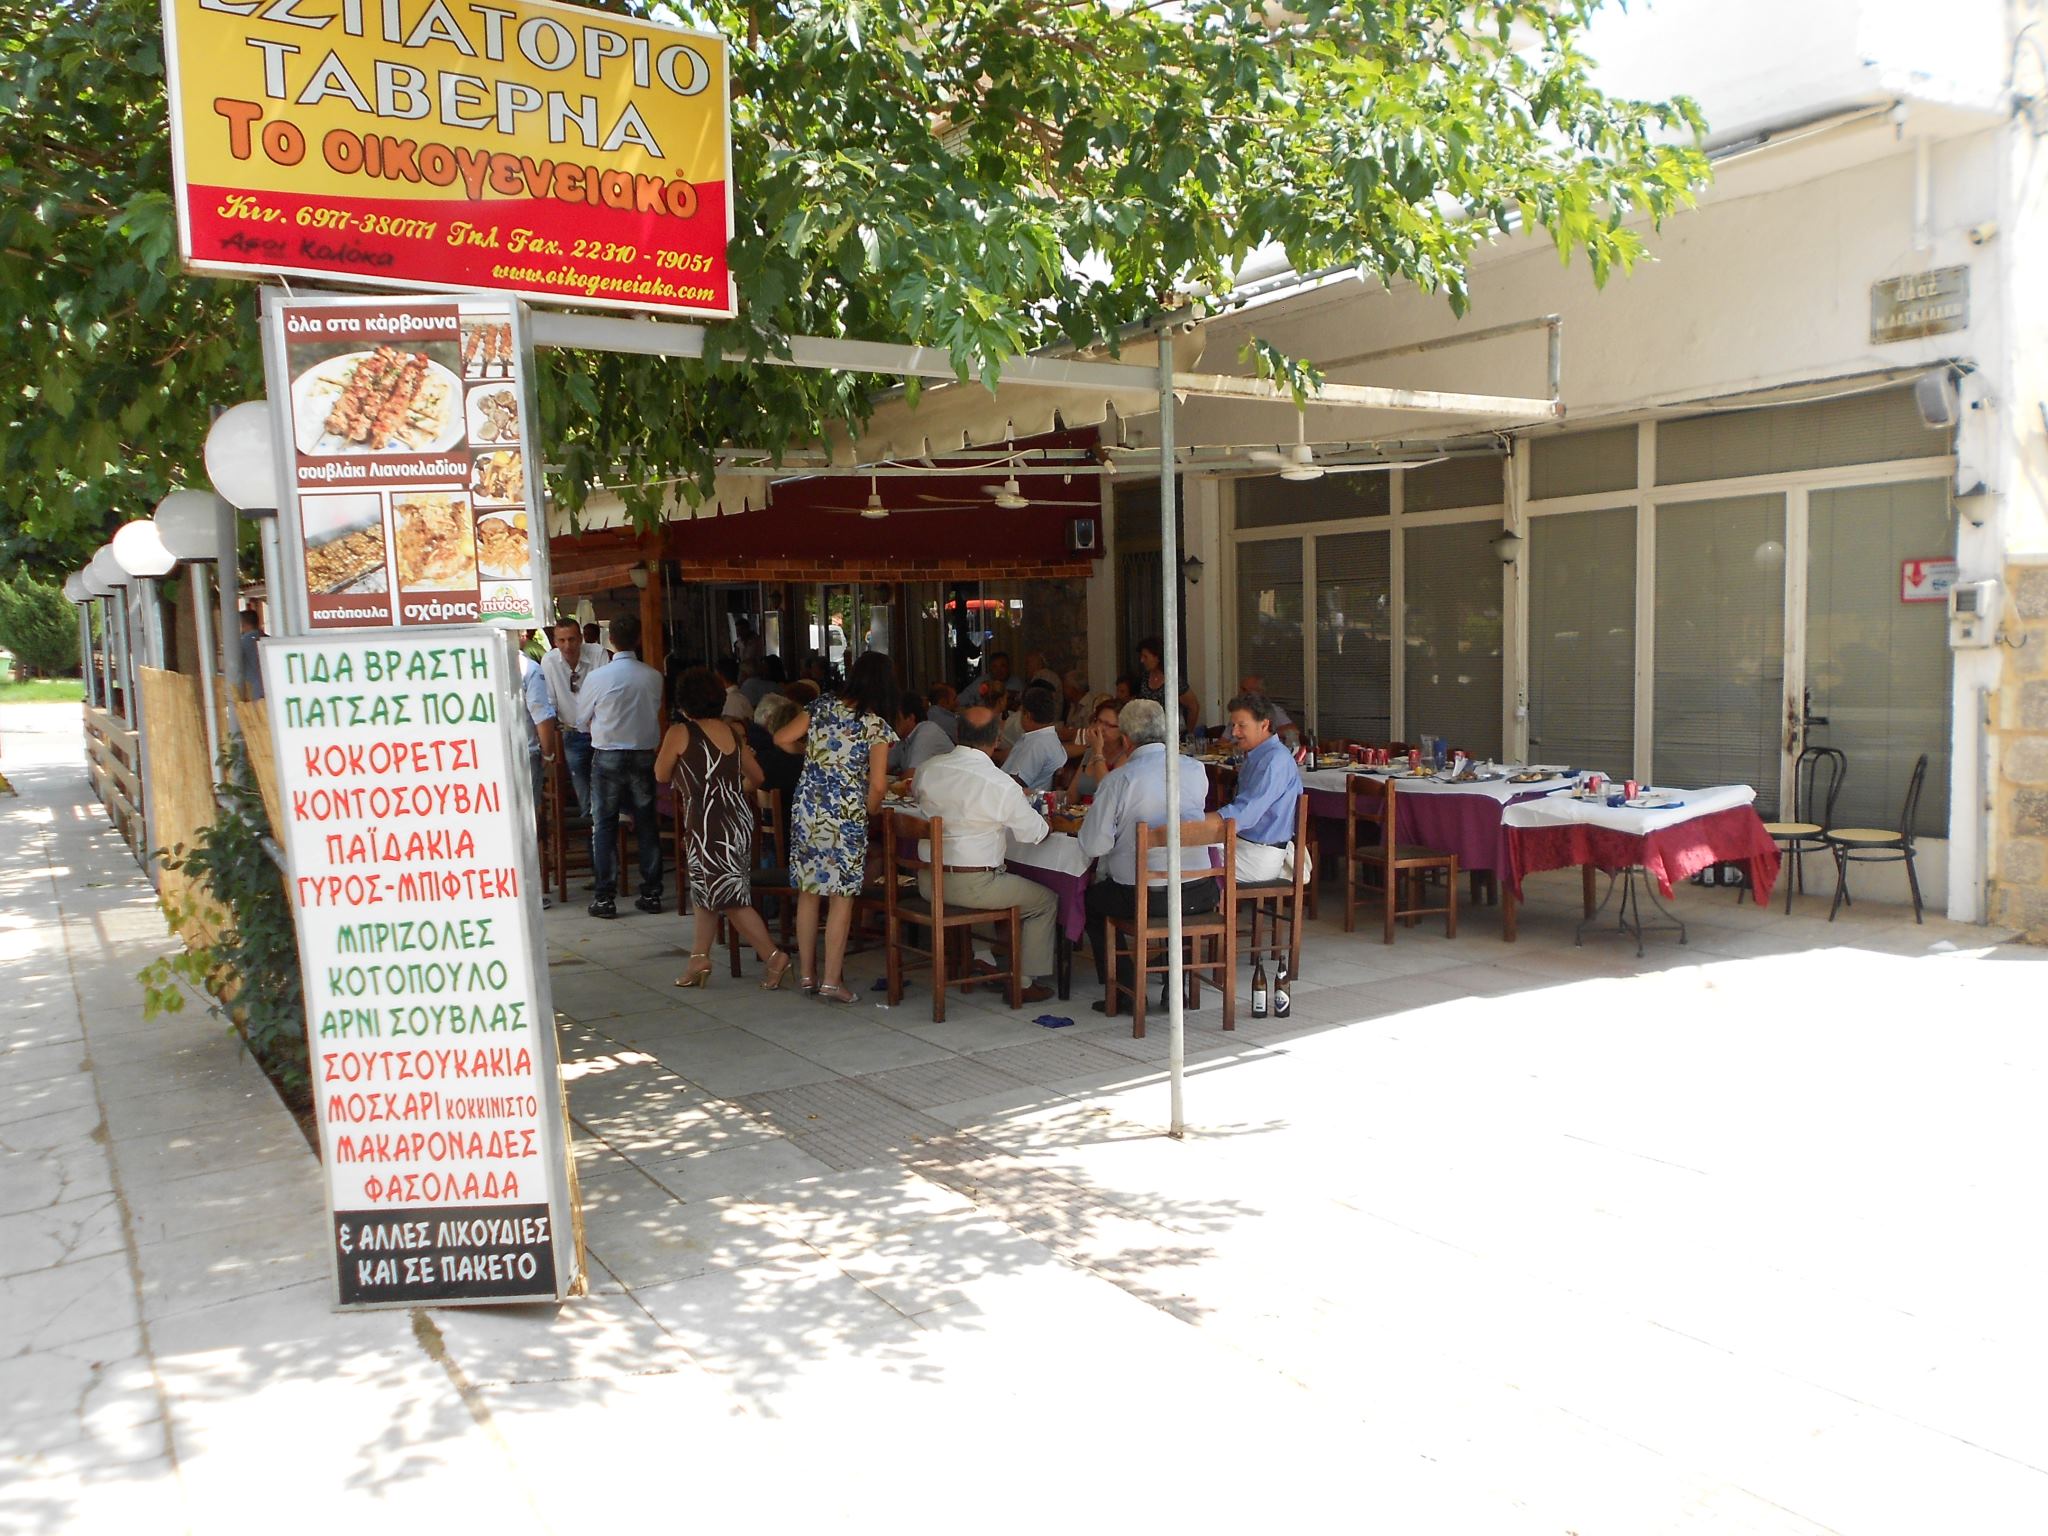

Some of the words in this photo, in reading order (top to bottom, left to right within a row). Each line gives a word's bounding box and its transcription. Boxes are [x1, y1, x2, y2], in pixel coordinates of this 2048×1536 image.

[199, 0, 710, 96] ΙΑΤΟΡΙΟ
[245, 37, 664, 159] ΤΑΒΕΡΝΑ
[214, 97, 306, 167] Το
[322, 128, 699, 220] οικογενειακό
[296, 206, 437, 240] 6977-380771
[507, 228, 564, 256] Fax.
[570, 239, 636, 264] 22310
[656, 250, 713, 273] 79051
[491, 264, 715, 302] www.oikogeneiako.com
[288, 315, 321, 333] όλα
[326, 318, 360, 332] στα
[365, 313, 457, 334] κάρβουνα
[299, 460, 366, 482] σουβλάκι
[313, 605, 388, 620] κοτόπουλα
[404, 599, 478, 621] σχάρας
[481, 596, 531, 614] πίνδος
[286, 652, 353, 683] ΓΙΔΑ
[364, 648, 488, 681] ΒΡΑΣΤΗ
[285, 694, 412, 728] ΠΑΤΣΑΣ
[422, 692, 496, 724] ΠΟΔΙ
[305, 738, 479, 777] ΚΟΚΟΡΕΤΣΙ
[293, 782, 501, 821] ΚΟΝΤΟΣΟΥΒΛΙ
[326, 827, 475, 865] ΠΑΪΔΑΚΙΑ
[297, 867, 519, 907] ΓΥΡΟΣ-ΜΠΙΦΤΕΚΙ
[337, 918, 495, 954] ΜΠΡΙΖΟΛΕΣ
[328, 959, 508, 997] ΚΟΤΟΠΟΥΛΟ
[320, 1008, 381, 1039] ΑΡΝΙ
[389, 1001, 527, 1037] ΣΟΥΒΛΑΣ
[323, 1047, 532, 1083] ΣΟΥΤΣΟΥΚΑΚΙΑ
[328, 1091, 441, 1123] ΜΟΣΧΑΡΙ
[445, 1095, 538, 1120] ΚΟΚΚΙΝΙΣΤΟ
[337, 1128, 538, 1163] ΜΑΚΑΡΟΝΑΔΕΣ
[364, 1171, 519, 1203] ΦΑΣΟΛΑΔΑ
[359, 1222, 432, 1250] ΑΛΛΕΣ
[437, 1217, 550, 1248] ΛΙΧΟΥΔΙΕΣ
[358, 1258, 398, 1286] ΚΑΙ
[403, 1257, 435, 1284] ΣΕ
[441, 1252, 537, 1282] ΠΑΚΕΤΟ
